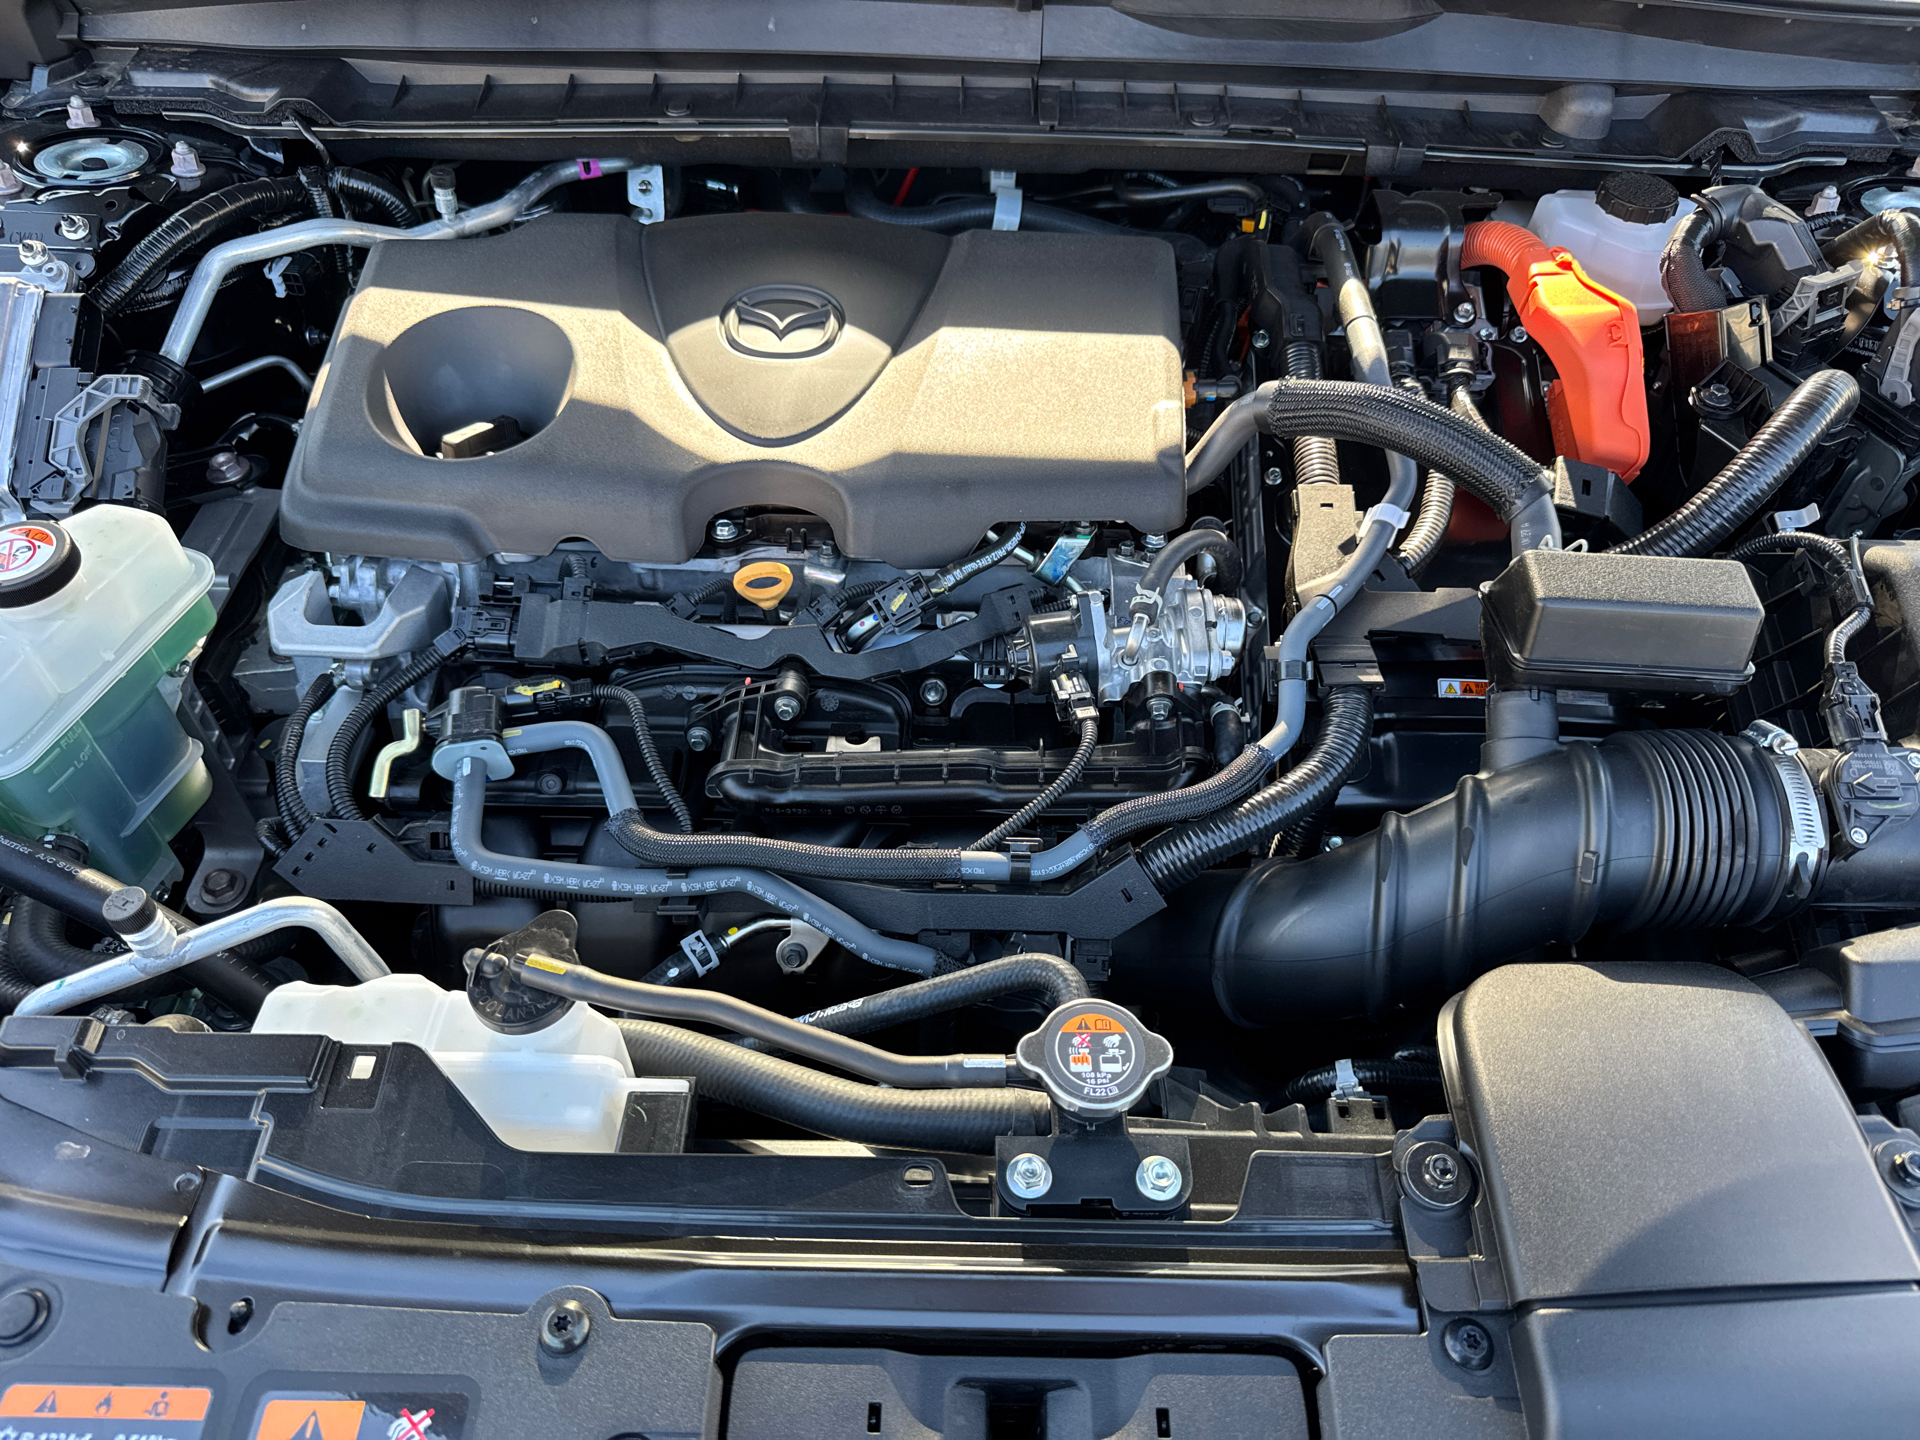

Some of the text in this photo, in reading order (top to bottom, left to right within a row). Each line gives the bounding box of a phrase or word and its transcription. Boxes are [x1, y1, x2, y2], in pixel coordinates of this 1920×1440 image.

[60, 726, 82, 749] FULL
[74, 744, 93, 769] LOW
[36, 853, 56, 864] A/C
[1084, 1087, 1106, 1096] FL22
